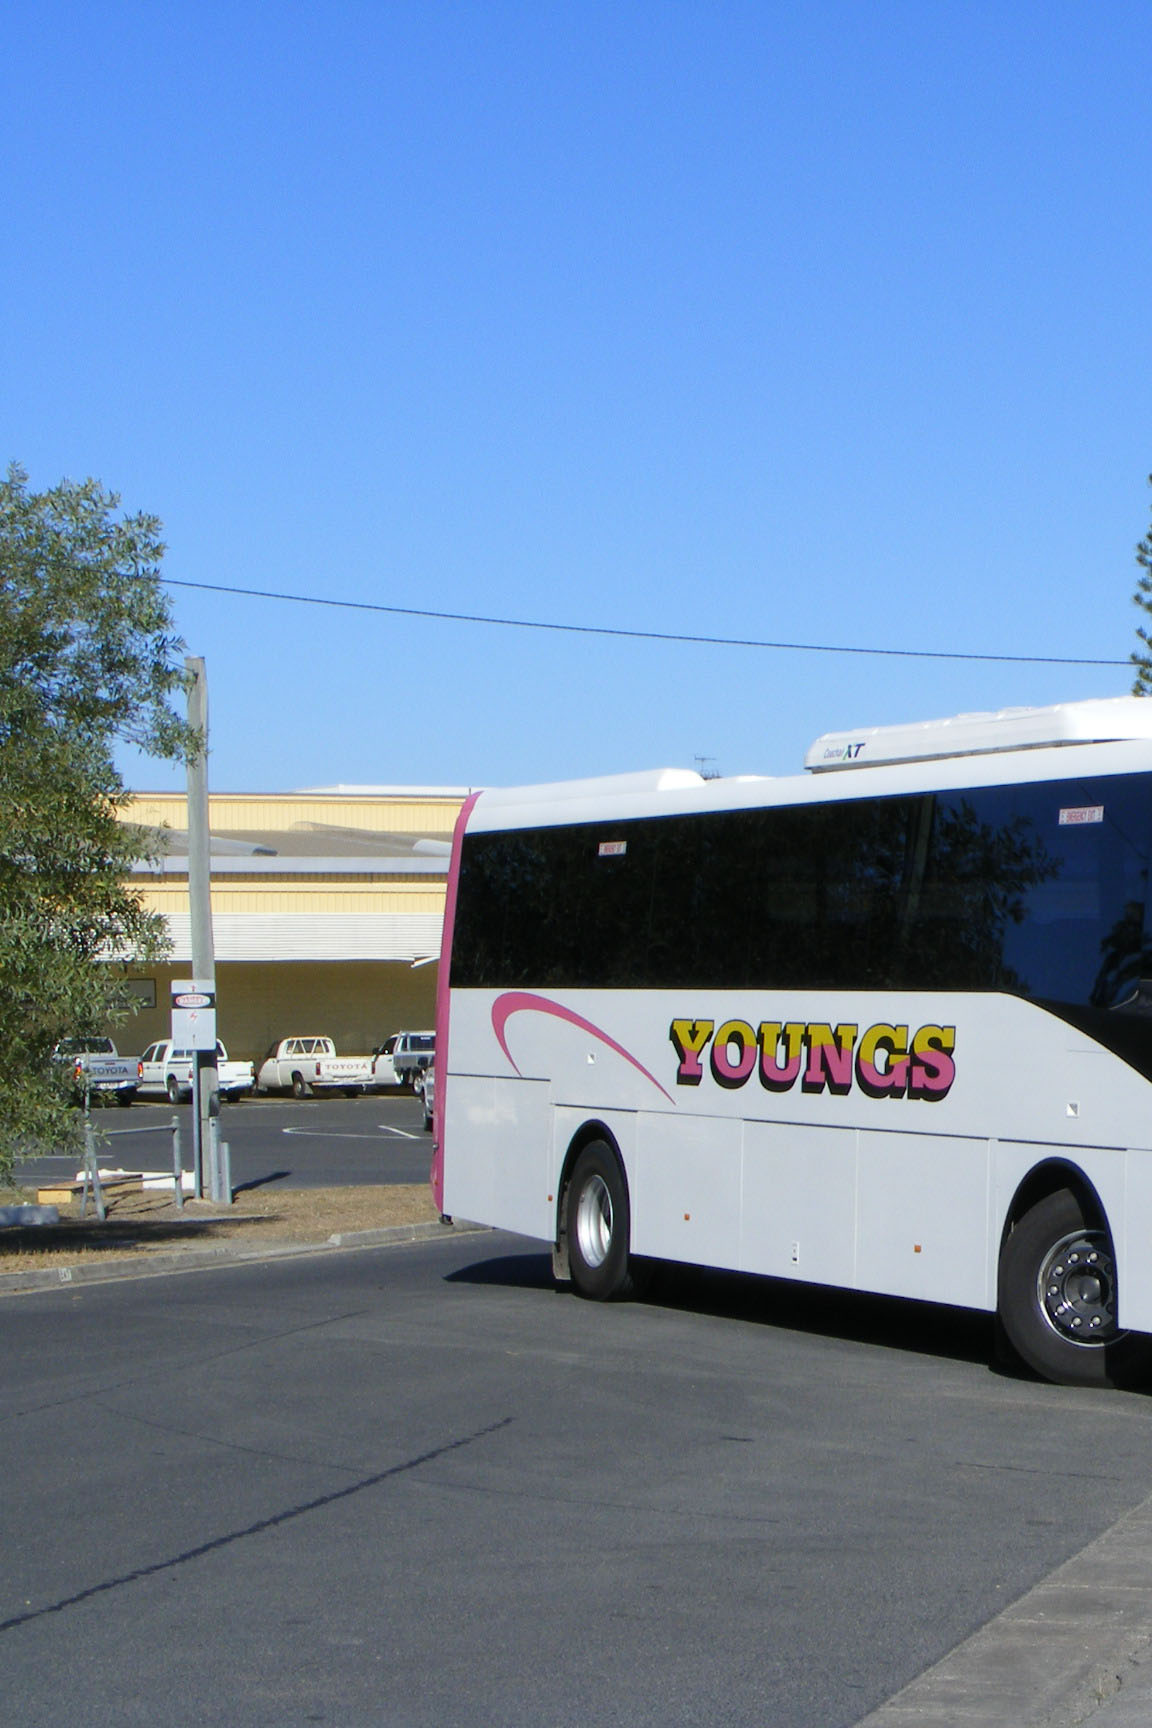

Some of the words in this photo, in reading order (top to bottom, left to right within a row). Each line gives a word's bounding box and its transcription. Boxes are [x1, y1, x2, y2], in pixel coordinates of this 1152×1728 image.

[670, 1018, 956, 1102] YOUNGS
[91, 1066, 129, 1075] TOYOTA
[325, 1063, 368, 1071] TOYOTA
